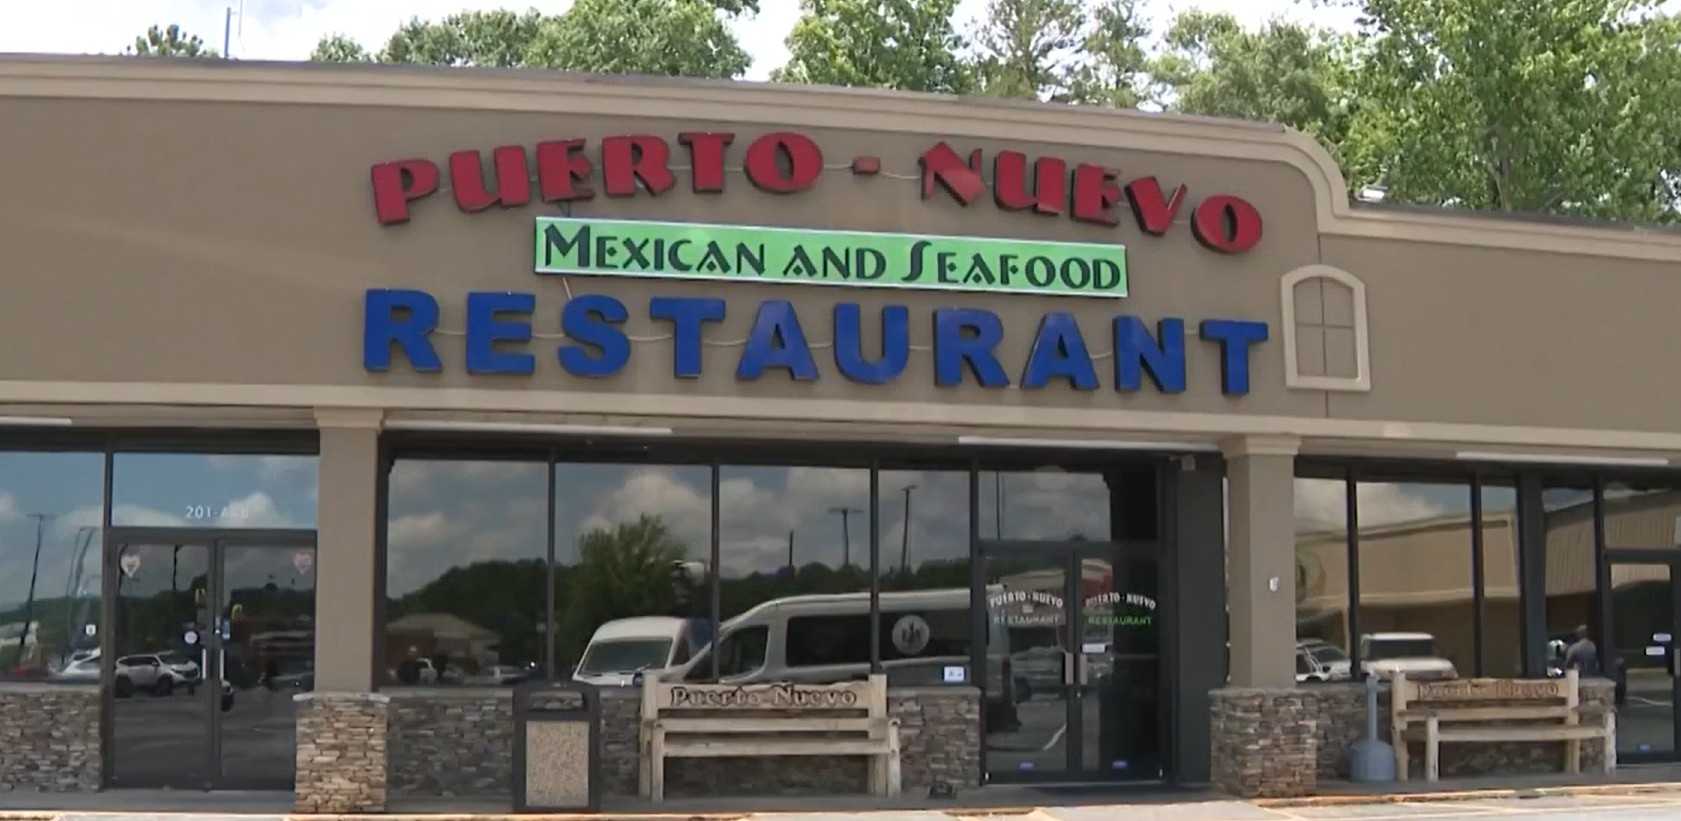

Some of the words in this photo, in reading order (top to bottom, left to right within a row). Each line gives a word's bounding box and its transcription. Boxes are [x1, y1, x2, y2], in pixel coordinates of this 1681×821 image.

[371, 131, 824, 225] PUERTO
[918, 140, 1264, 254] NUEVO
[544, 223, 765, 276] MEXICAN
[783, 244, 887, 281] AND
[902, 240, 1121, 290] SEAFOOD
[364, 288, 1269, 396] RESTAURANT
[671, 686, 762, 706] Puerto
[770, 682, 857, 706] Nuevo
